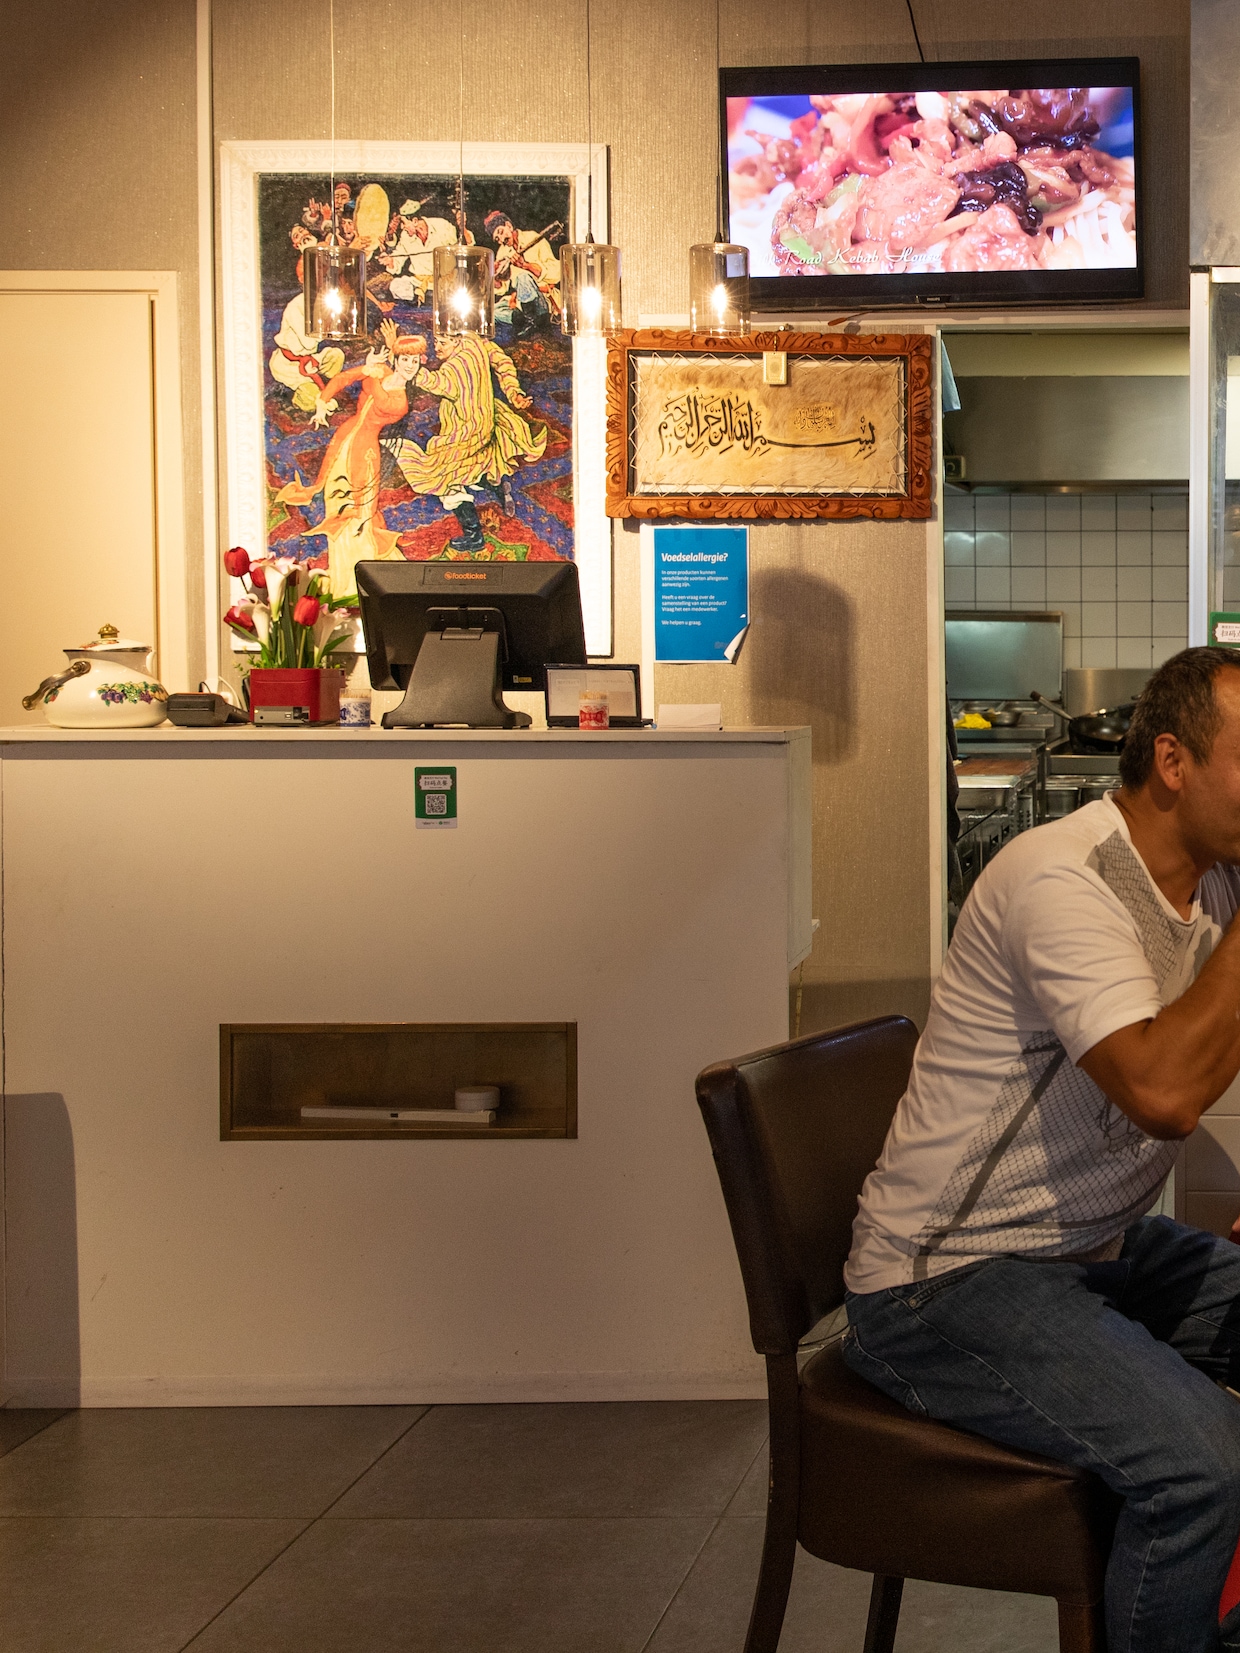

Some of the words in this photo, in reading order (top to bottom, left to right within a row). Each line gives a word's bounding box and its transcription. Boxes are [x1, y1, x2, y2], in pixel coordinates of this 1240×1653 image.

[784, 250, 823, 265] Road
[827, 248, 879, 264] Kebab
[885, 246, 940, 263] House
[661, 552, 728, 564] Voedselallergie?
[452, 572, 486, 580] foodticket
